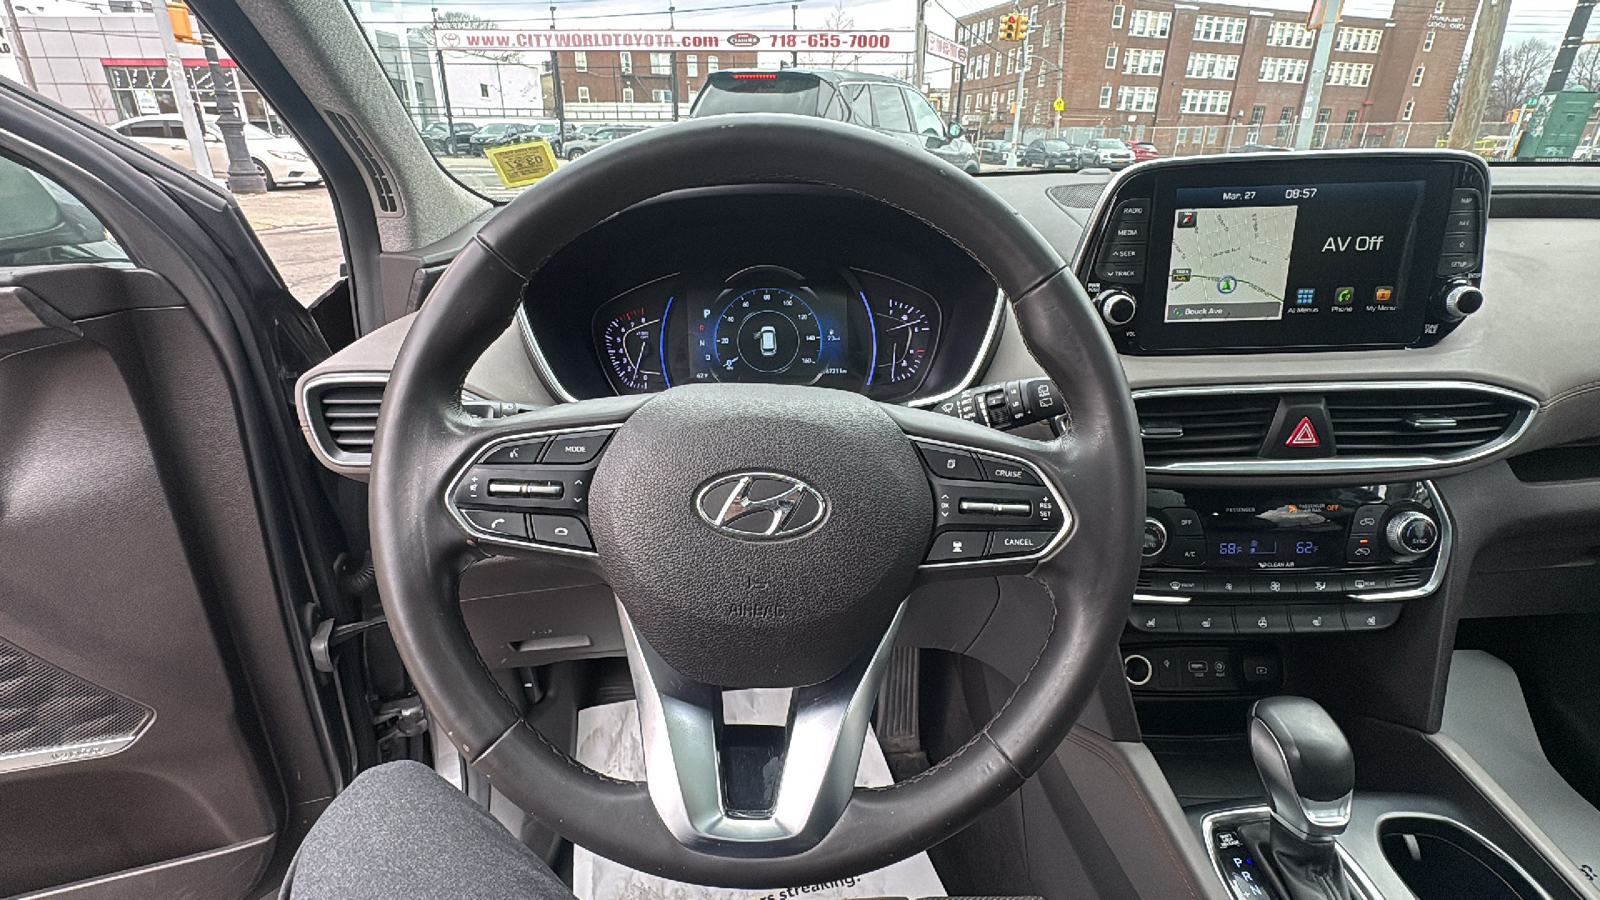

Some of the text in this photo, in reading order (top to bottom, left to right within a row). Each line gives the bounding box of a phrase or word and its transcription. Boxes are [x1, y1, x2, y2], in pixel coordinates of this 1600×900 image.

[466, 32, 719, 48] www.CITYWORLDTOYOTA.com
[769, 33, 890, 48] 718-655-7000
[1285, 188, 1317, 198] 08:57
[1322, 235, 1384, 252] AV Off
[703, 309, 711, 318] P
[995, 469, 1022, 478] CRUISE
[1004, 538, 1034, 546] CANCEL
[1184, 550, 1196, 558] A/C
[1232, 857, 1242, 868] P
[1241, 871, 1253, 882] R
[1249, 884, 1262, 896] N
